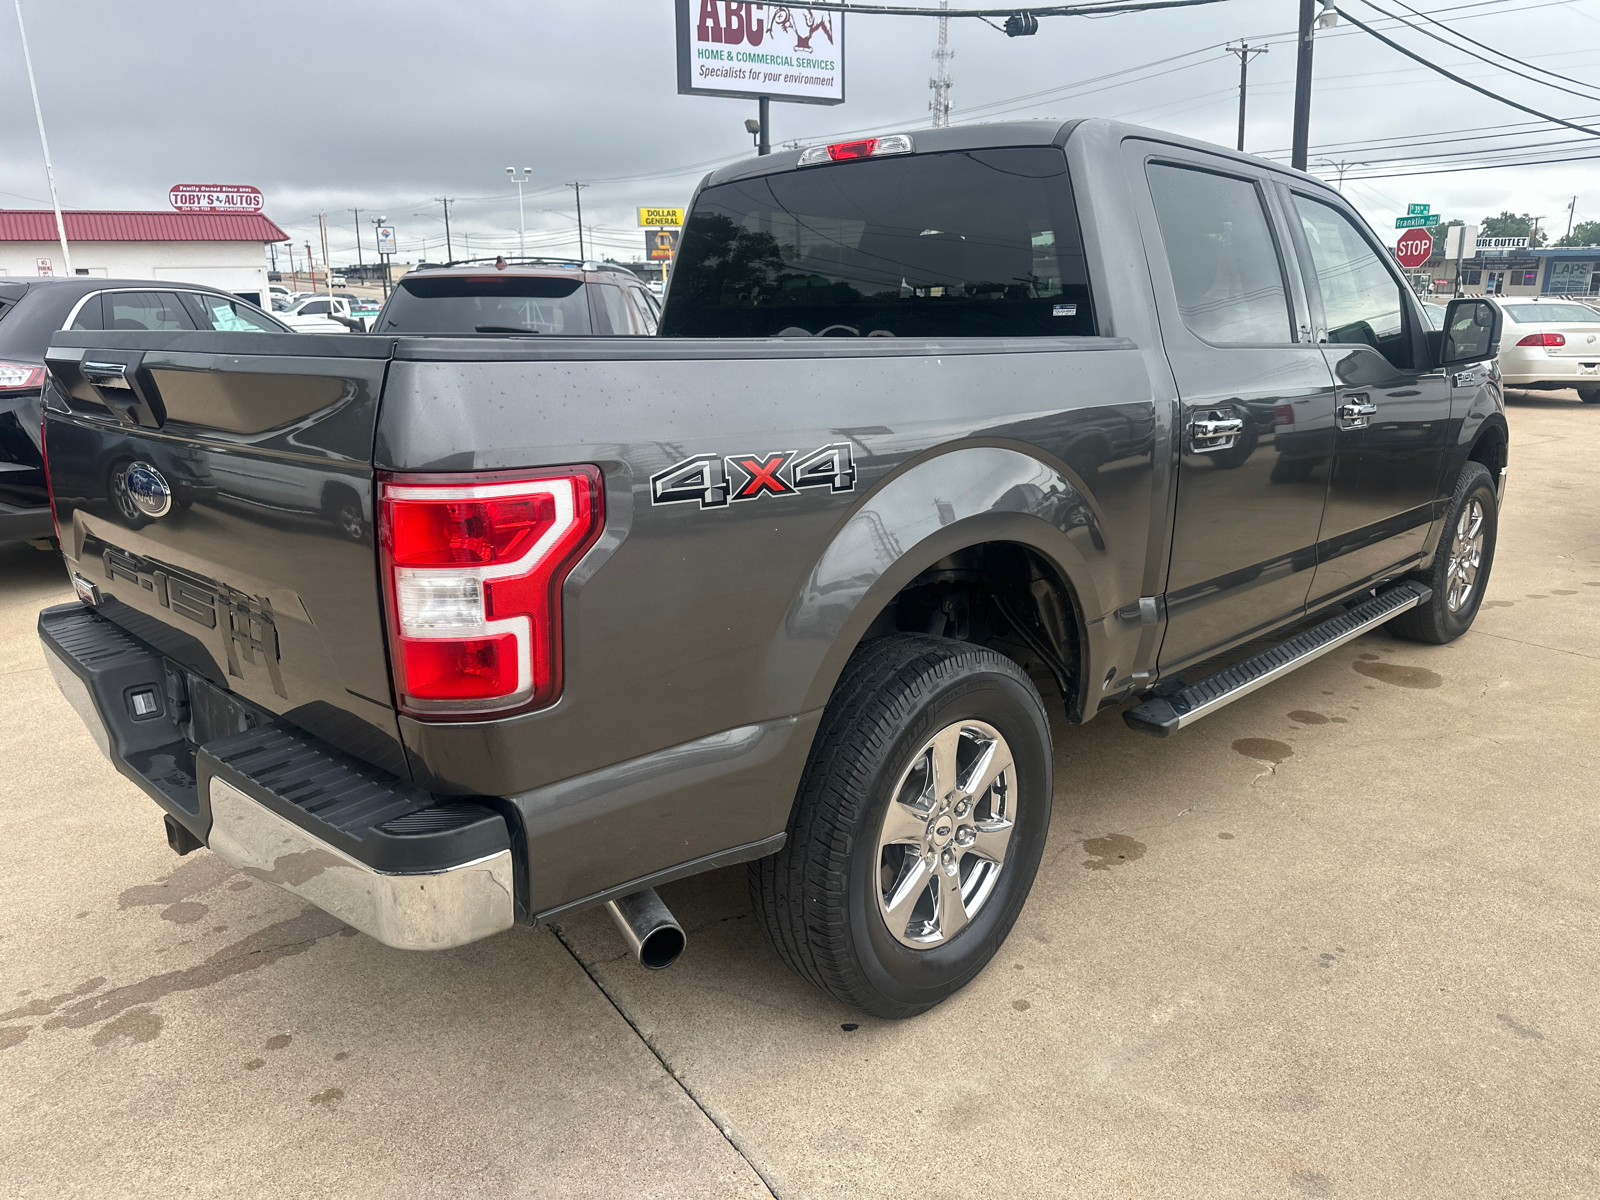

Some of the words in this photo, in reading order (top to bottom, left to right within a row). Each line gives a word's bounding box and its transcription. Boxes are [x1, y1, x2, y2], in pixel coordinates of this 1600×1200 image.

[697, 0, 764, 46] ABC
[697, 48, 725, 61] HOME
[726, 51, 734, 61] &
[736, 51, 794, 67] COMMERCIAL
[796, 57, 835, 71] SERVICES
[699, 64, 747, 79] Specialists
[749, 69, 761, 80] for
[762, 73, 782, 83] your
[783, 73, 834, 87] environment
[173, 194, 214, 205] TOBY'S
[224, 195, 260, 206] AUTOS
[1396, 218, 1425, 227] Franklin
[1398, 240, 1430, 256] STOP
[1494, 238, 1527, 247] OUTLET
[1552, 264, 1587, 274] LAPS
[876, 703, 935, 802] MICHELIN
